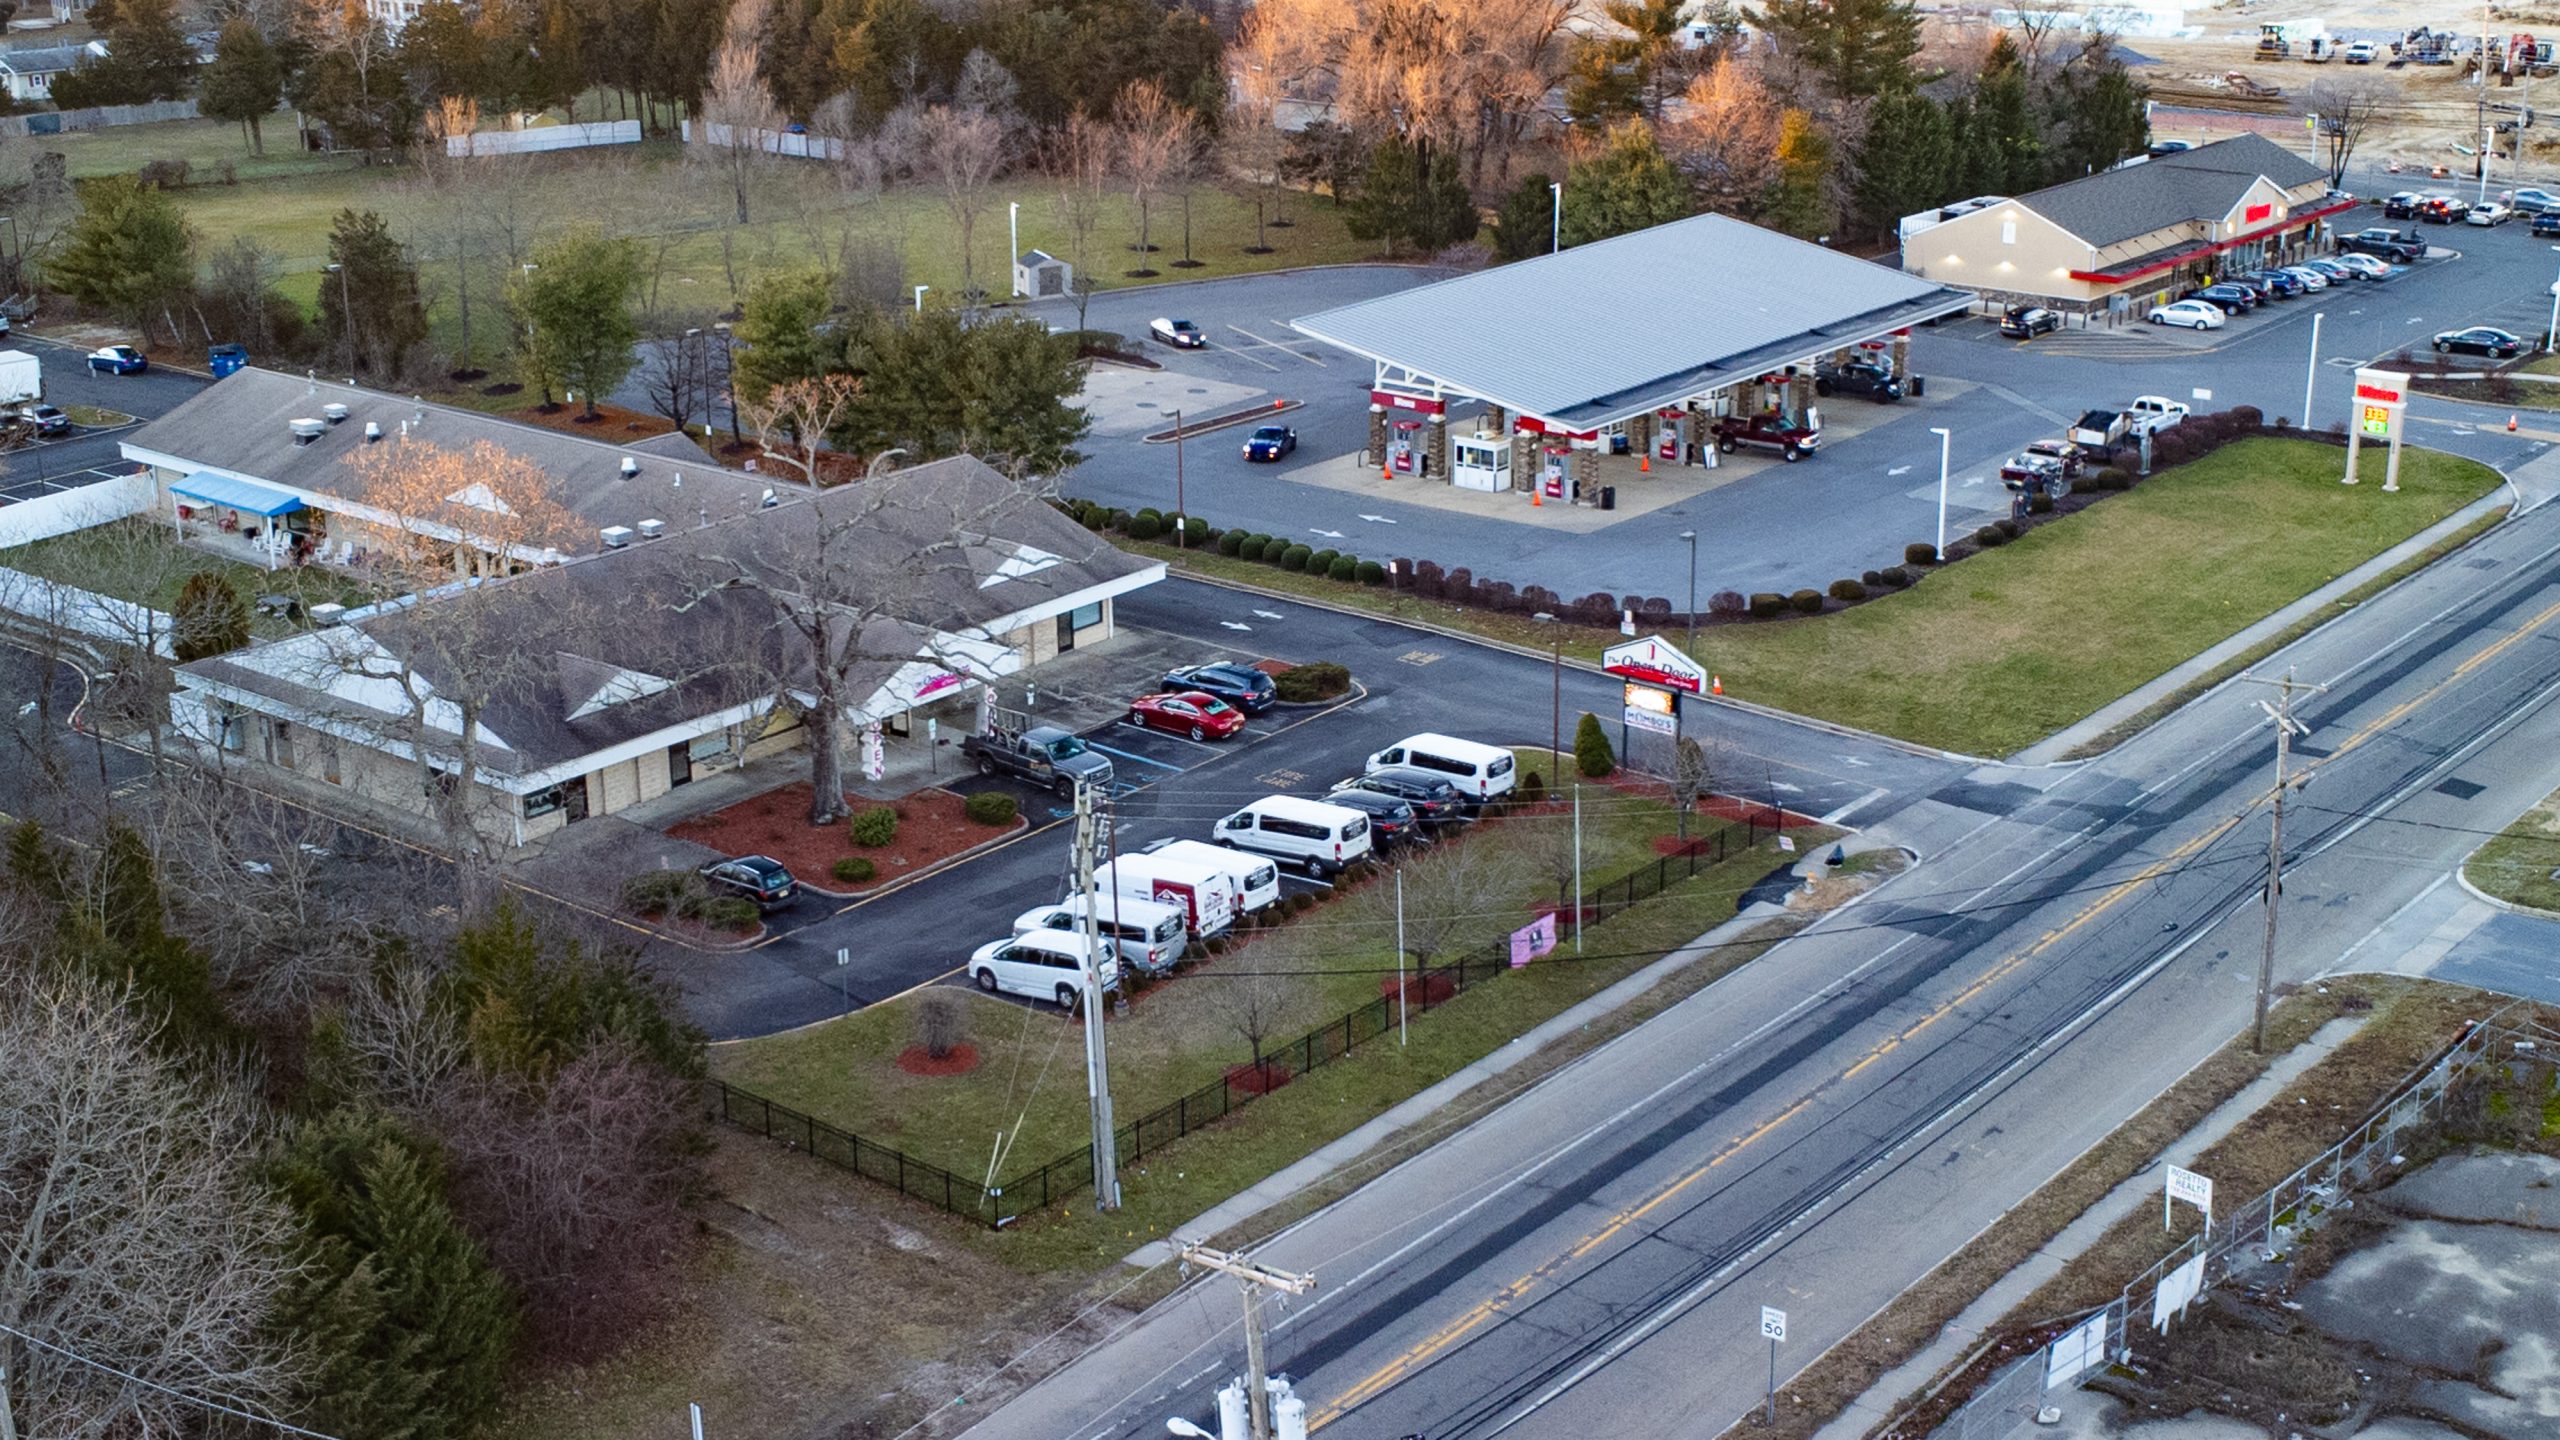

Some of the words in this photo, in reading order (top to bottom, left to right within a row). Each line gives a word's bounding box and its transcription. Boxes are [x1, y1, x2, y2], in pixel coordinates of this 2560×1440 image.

[1621, 655, 1655, 671] Open
[1662, 663, 1695, 679] Door
[873, 721, 881, 776] OPEN
[2170, 1167, 2207, 1188] ROSETTO
[2175, 1178, 2206, 1195] REALTY
[1764, 1322, 1783, 1336] 50
